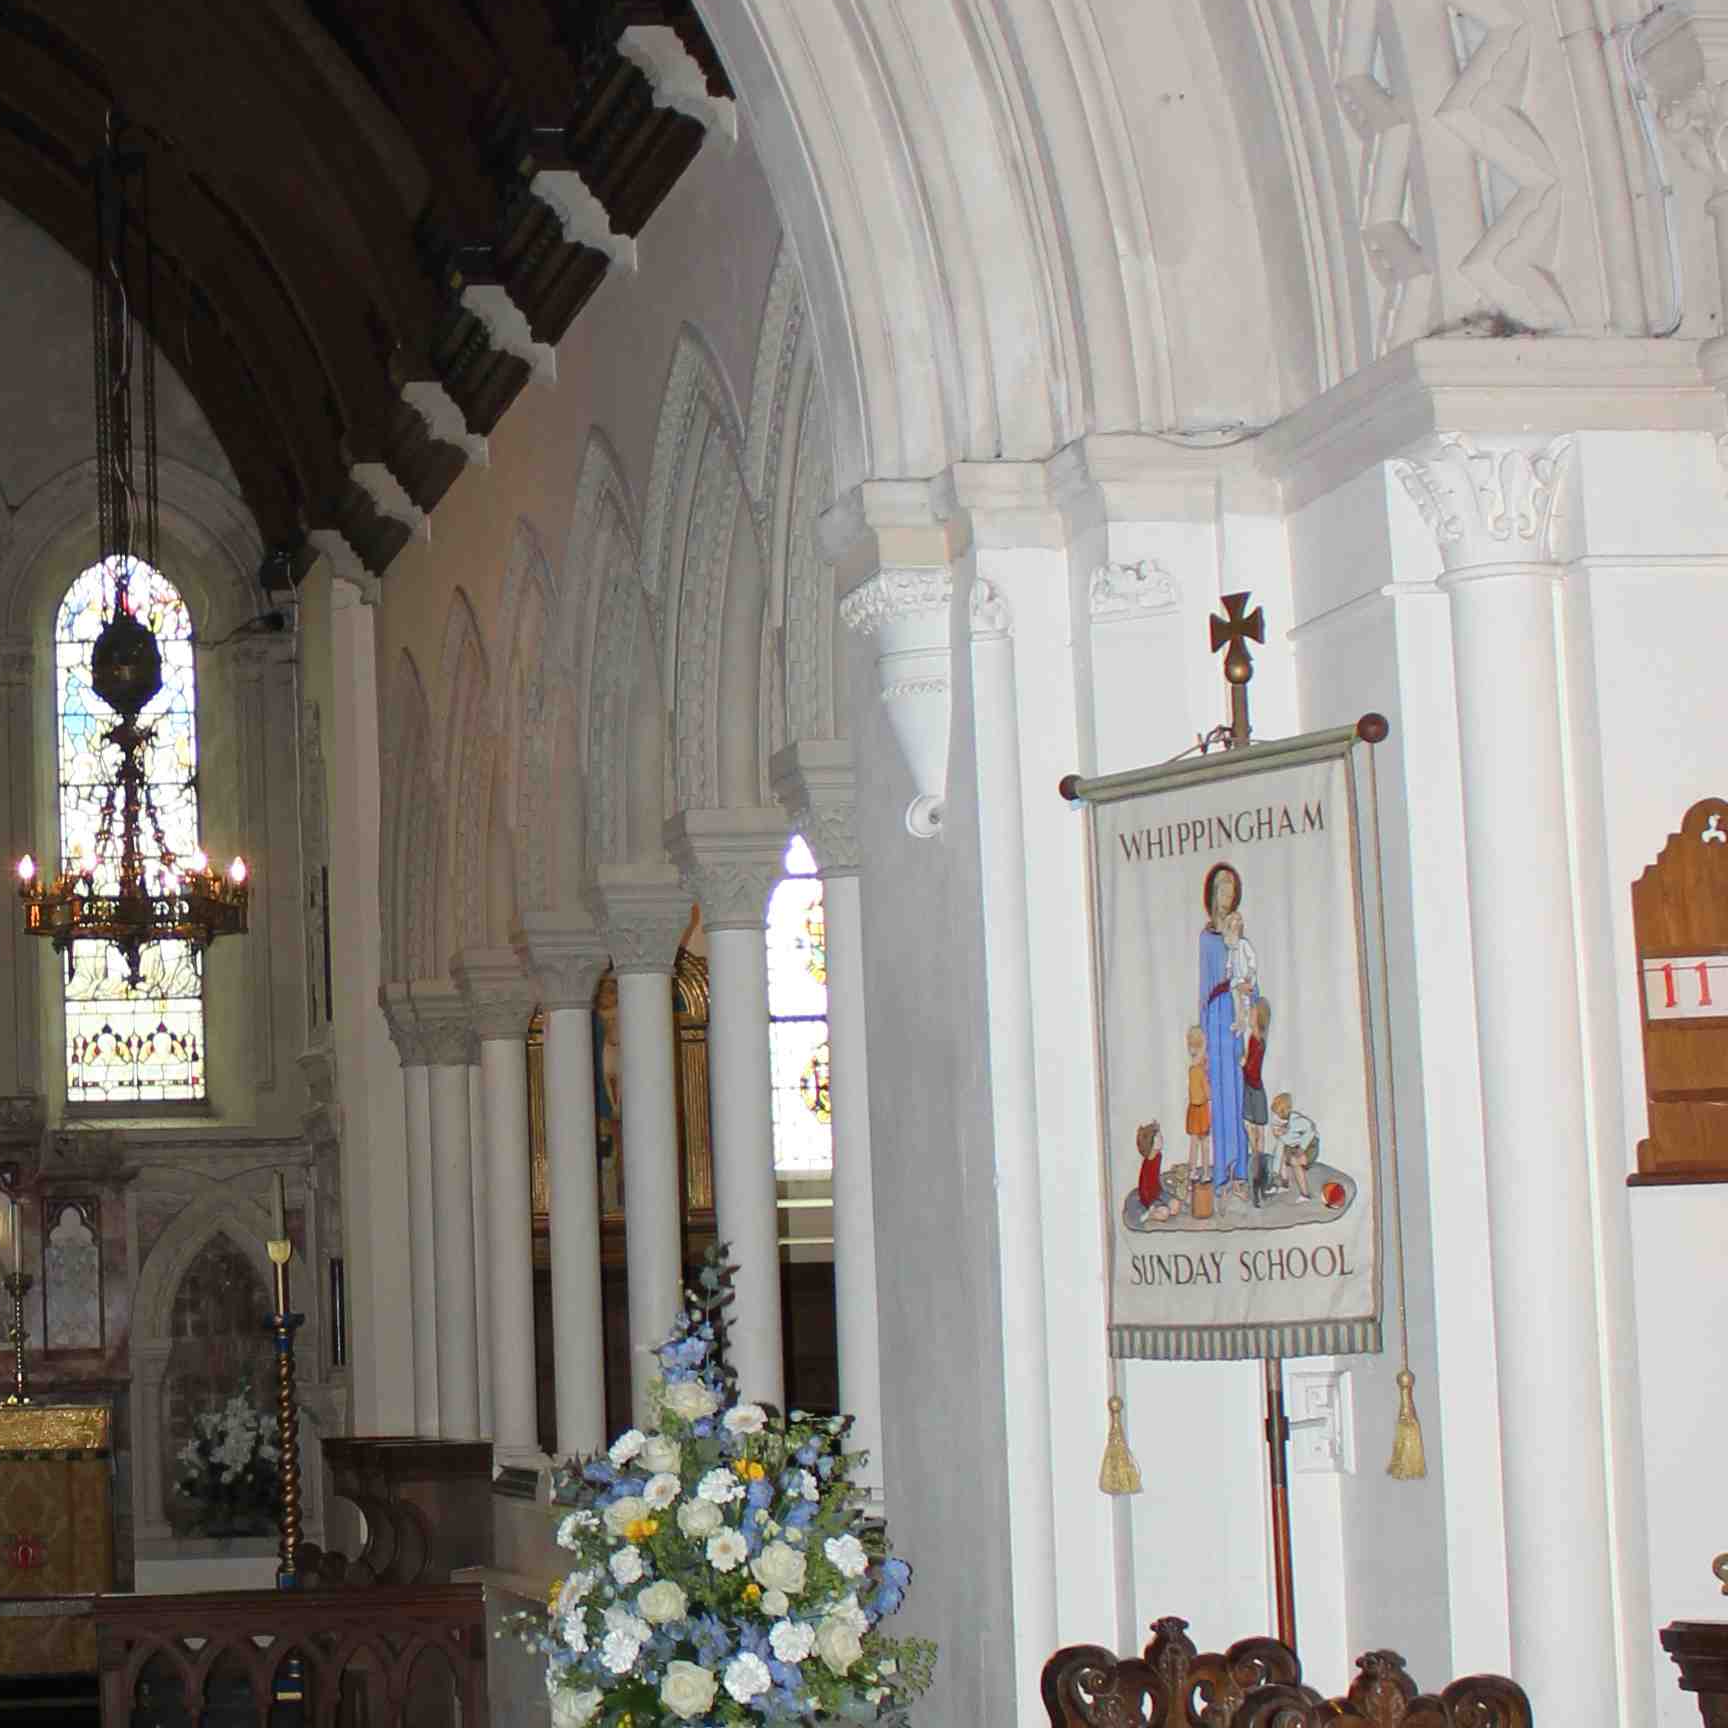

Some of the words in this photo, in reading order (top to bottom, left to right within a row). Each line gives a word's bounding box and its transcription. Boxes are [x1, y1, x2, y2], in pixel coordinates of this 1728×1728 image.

[1119, 799, 1325, 863] WHIPPINGHAM
[1130, 1251, 1225, 1286] SUNDAY
[1238, 1244, 1354, 1283] SCHOOL
